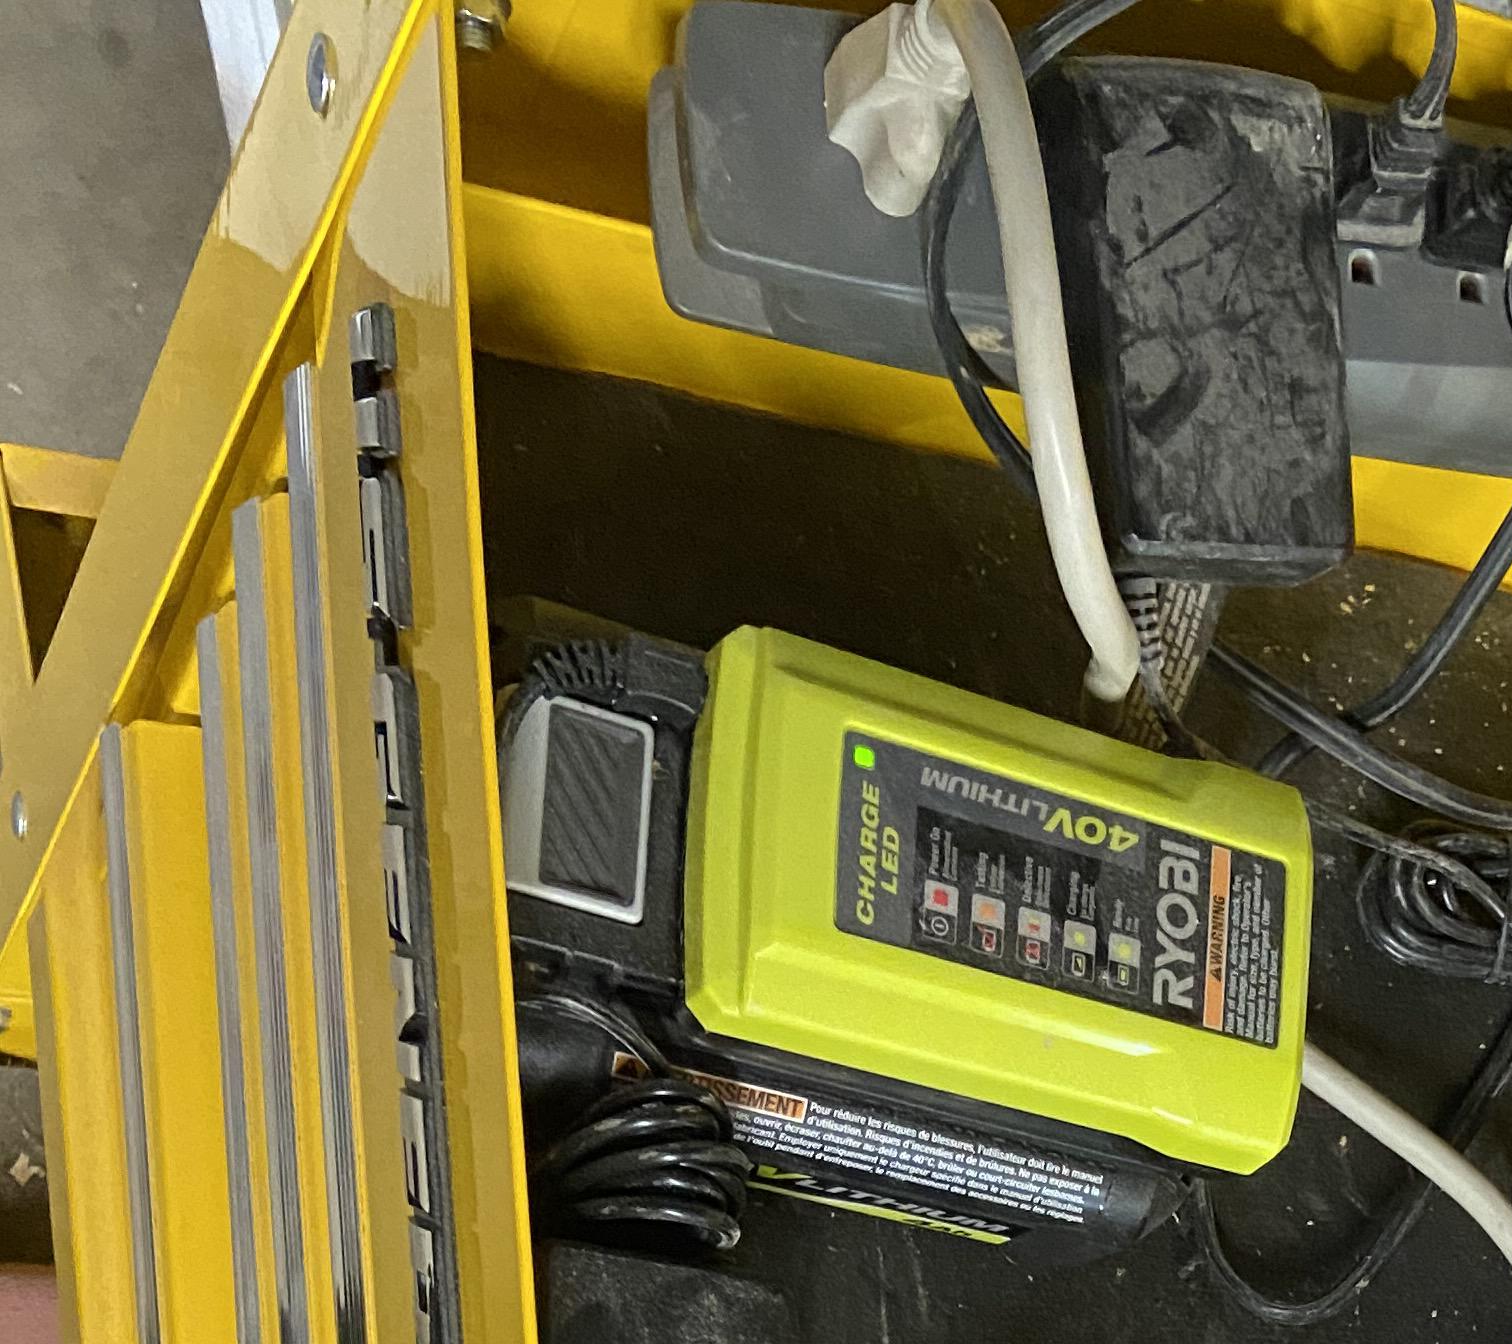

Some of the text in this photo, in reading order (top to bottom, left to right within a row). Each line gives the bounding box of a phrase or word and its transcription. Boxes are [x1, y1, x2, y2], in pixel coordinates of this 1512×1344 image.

[921, 765, 1049, 820] LITHIUM
[851, 779, 883, 926] CHARGE
[878, 823, 902, 894] LED
[1150, 836, 1202, 1014] RYOBI
[1208, 893, 1226, 969] WARNING
[808, 1100, 833, 1116] Pour
[867, 1116, 883, 1129] les
[881, 1120, 918, 1140] risques
[917, 1128, 931, 1141] de
[795, 1173, 1009, 1235] LITHIUM
